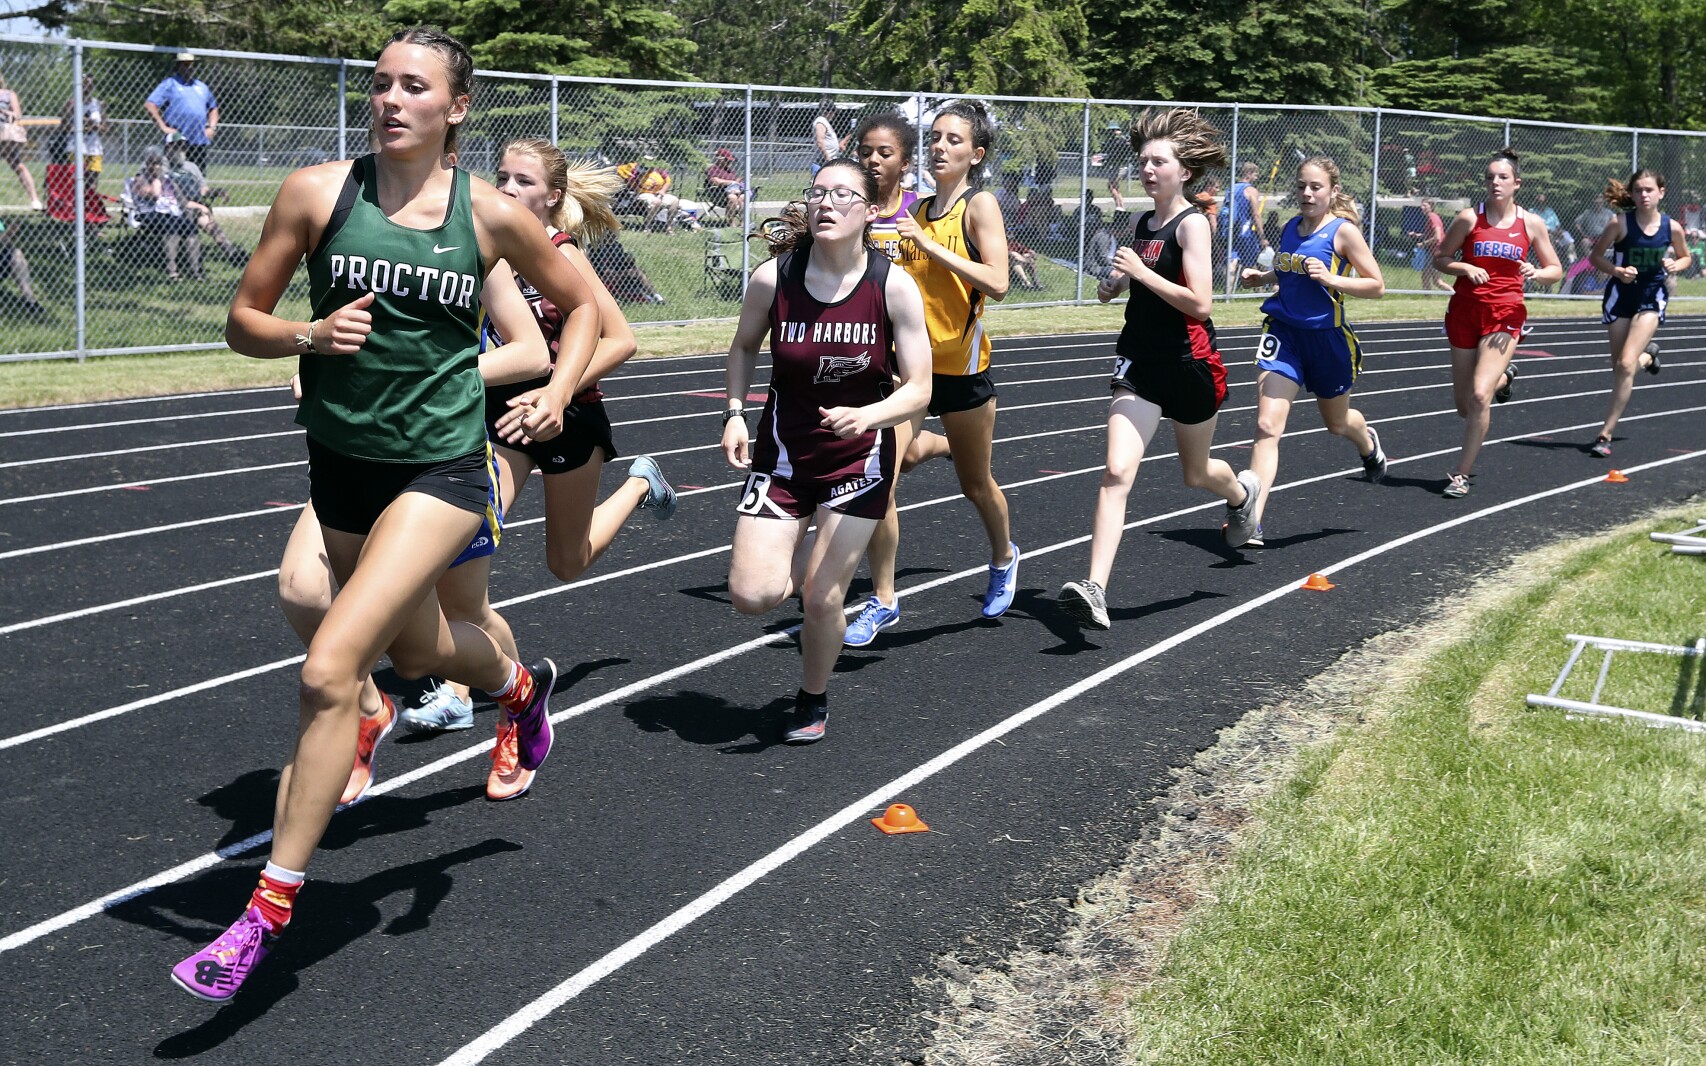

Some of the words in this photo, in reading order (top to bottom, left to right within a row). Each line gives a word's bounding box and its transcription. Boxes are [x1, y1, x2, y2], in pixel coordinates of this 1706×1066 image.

[1474, 240, 1523, 261] REBELS
[330, 254, 476, 309] PROCTOR
[780, 321, 806, 343] TWO
[812, 322, 877, 345] HARBORS
[1260, 335, 1278, 358] 9
[1114, 357, 1126, 377] 3
[743, 474, 766, 510] 5
[830, 477, 873, 498] AGATES
